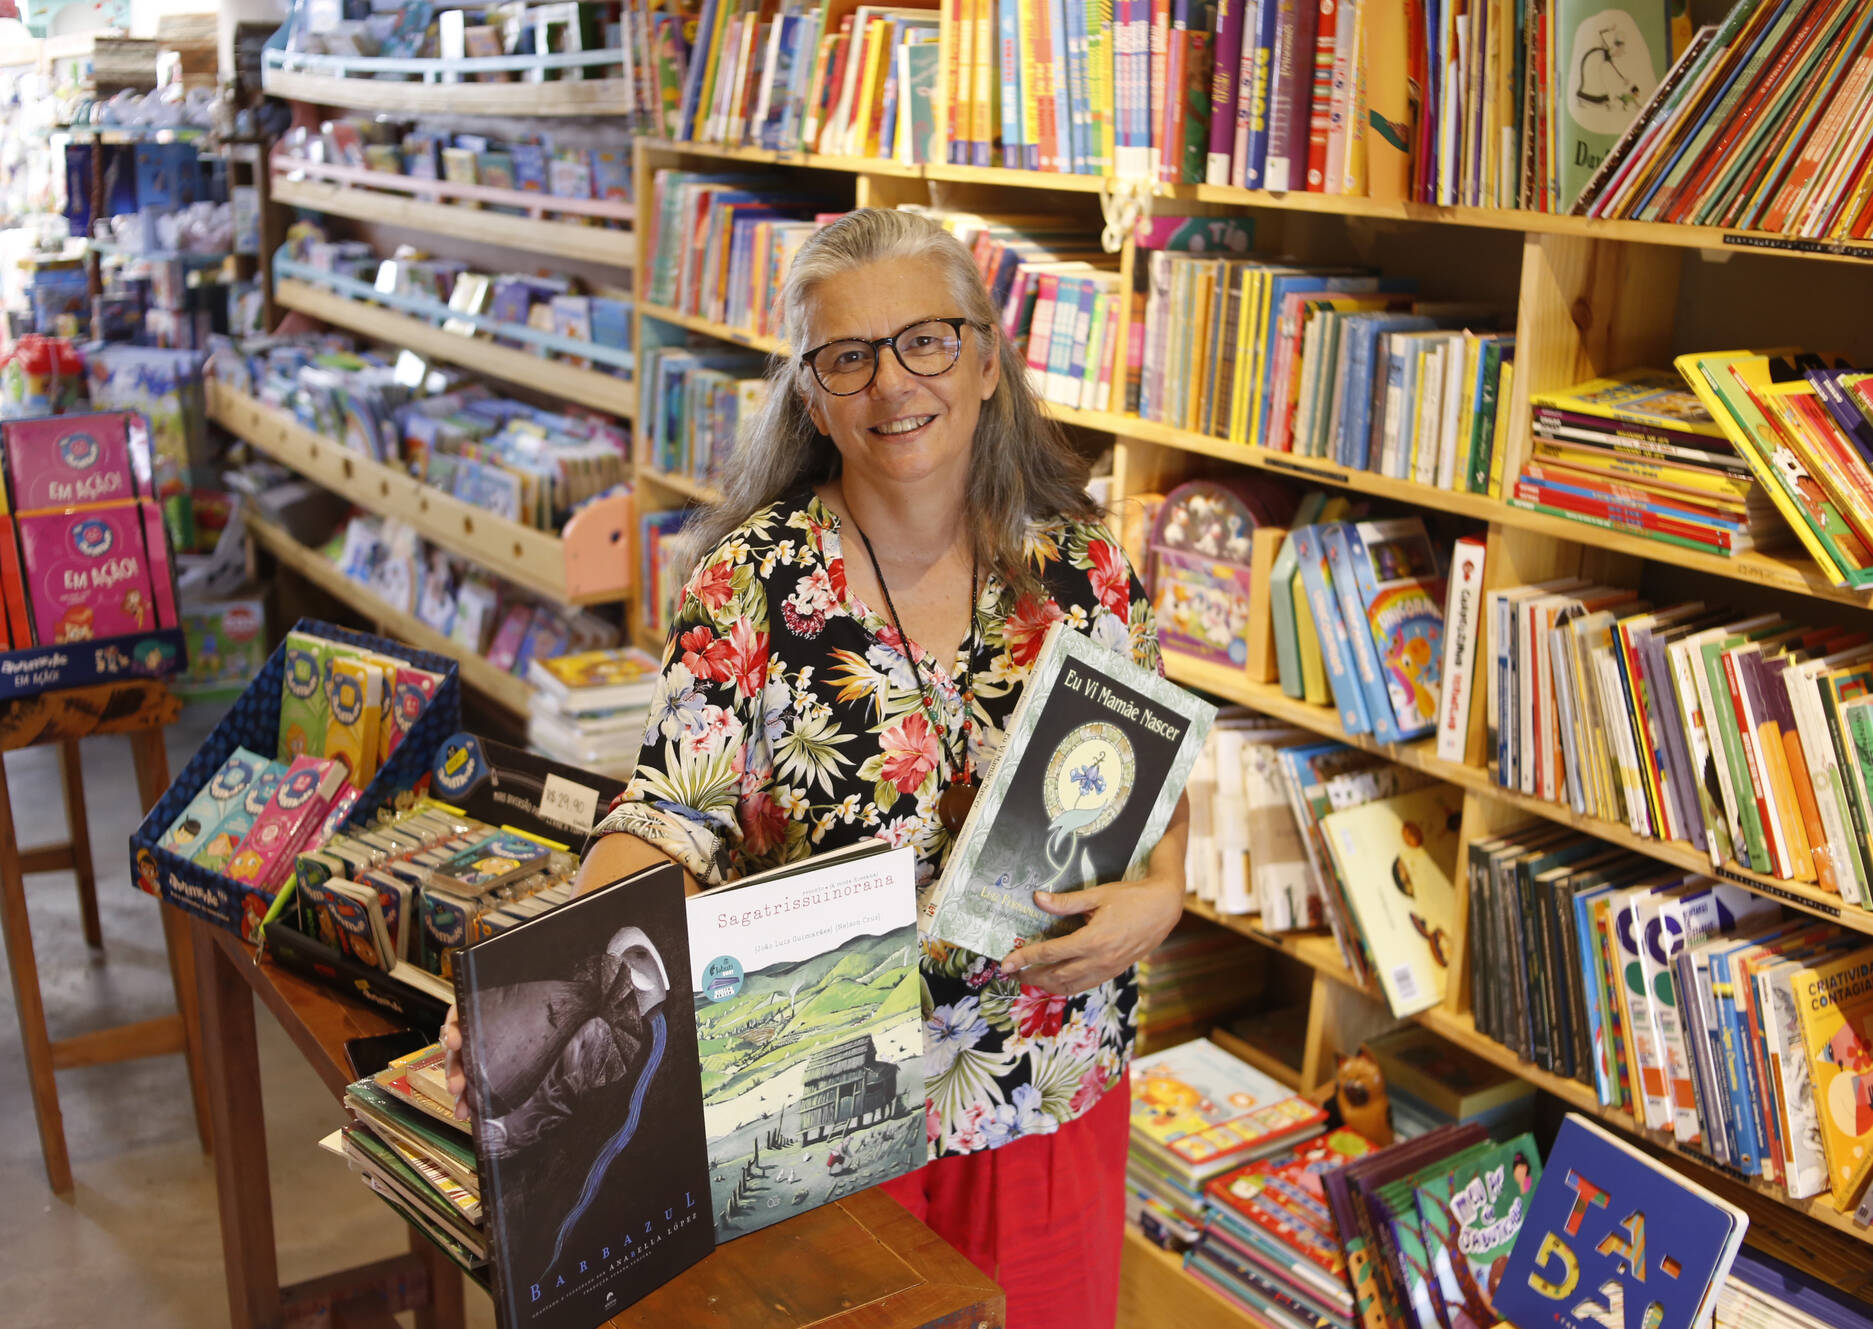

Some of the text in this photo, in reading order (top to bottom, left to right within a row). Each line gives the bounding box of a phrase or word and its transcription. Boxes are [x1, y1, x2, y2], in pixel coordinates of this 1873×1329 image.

[48, 480, 73, 500] EM
[63, 557, 139, 590] EM AÇÃO!
[1063, 668, 1083, 692] Eu
[1084, 678, 1099, 700] Vi
[1097, 686, 1140, 722] Mamãe
[1139, 708, 1180, 742] Nascer
[716, 874, 895, 928] Sagatrissuinorana
[529, 1191, 696, 1303] BARBAZUL
[608, 1234, 663, 1272] ANABELLA
[666, 1212, 698, 1236] LÓPEZ
